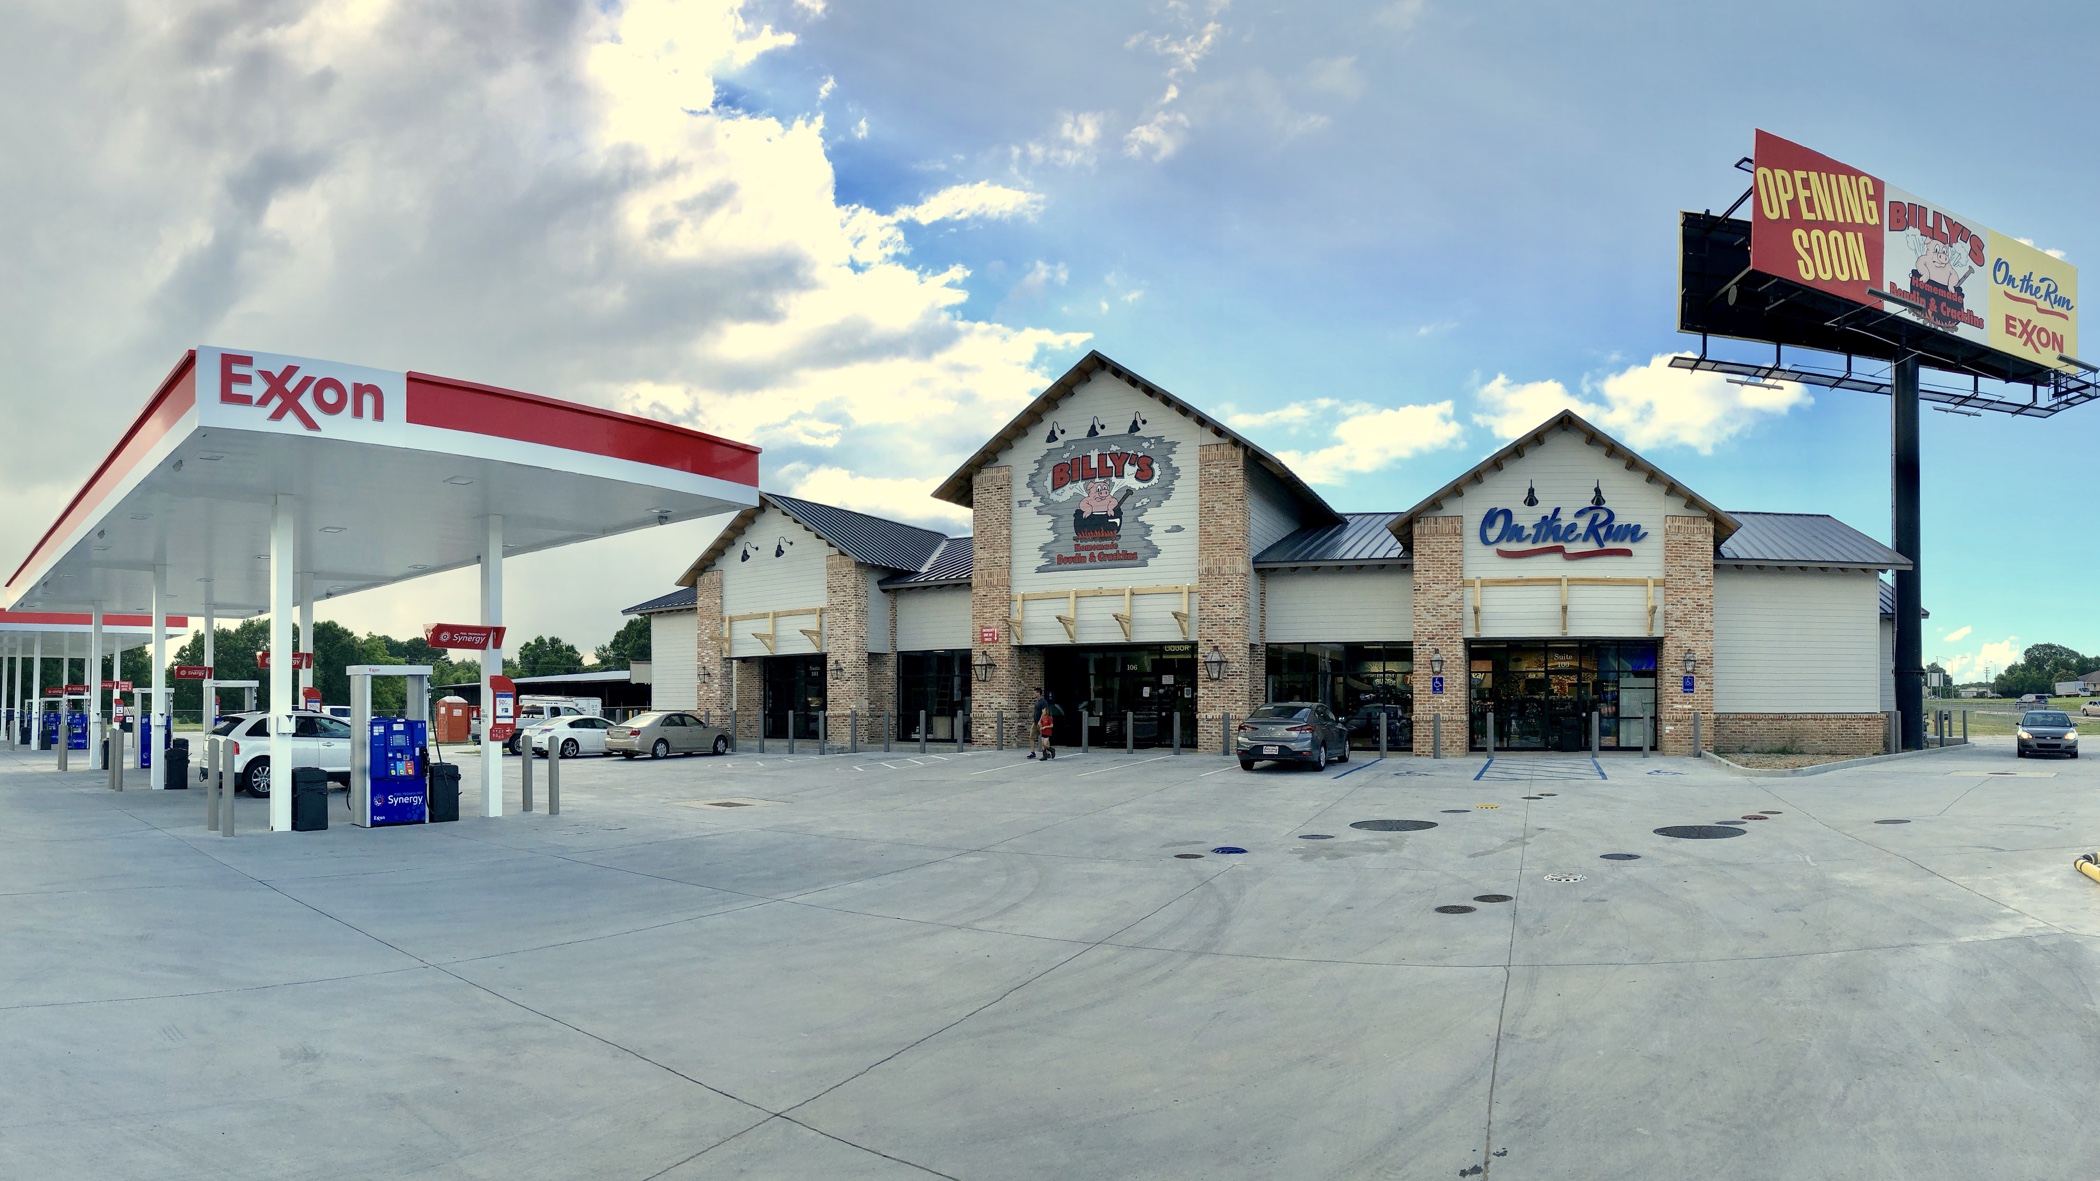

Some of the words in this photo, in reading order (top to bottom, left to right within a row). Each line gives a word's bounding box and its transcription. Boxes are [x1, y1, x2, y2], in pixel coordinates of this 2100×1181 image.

[1756, 166, 1880, 225] OPENING
[1792, 228, 1871, 282] SOON
[1888, 200, 1985, 268] BILLY'S
[1889, 281, 1926, 309] Boudin
[1929, 298, 1938, 312] &
[1940, 301, 1985, 330] Cracklins
[1911, 276, 1963, 304] Homemade
[1992, 257, 2019, 289] On
[2019, 271, 2043, 300] the
[2039, 277, 2075, 311] Run
[2005, 313, 2064, 355] EXXON
[219, 352, 385, 432] Exxon
[1052, 451, 1156, 492] BILLY'S
[1074, 542, 1118, 552] Homemade
[1479, 507, 1532, 546] On
[1531, 507, 1582, 545] the
[1573, 505, 1649, 549] Run
[1056, 553, 1087, 565] Boudin
[1089, 552, 1096, 562] &
[1097, 550, 1138, 561] Cracklins
[452, 633, 486, 645] Synergy
[387, 794, 424, 807] Synergy
